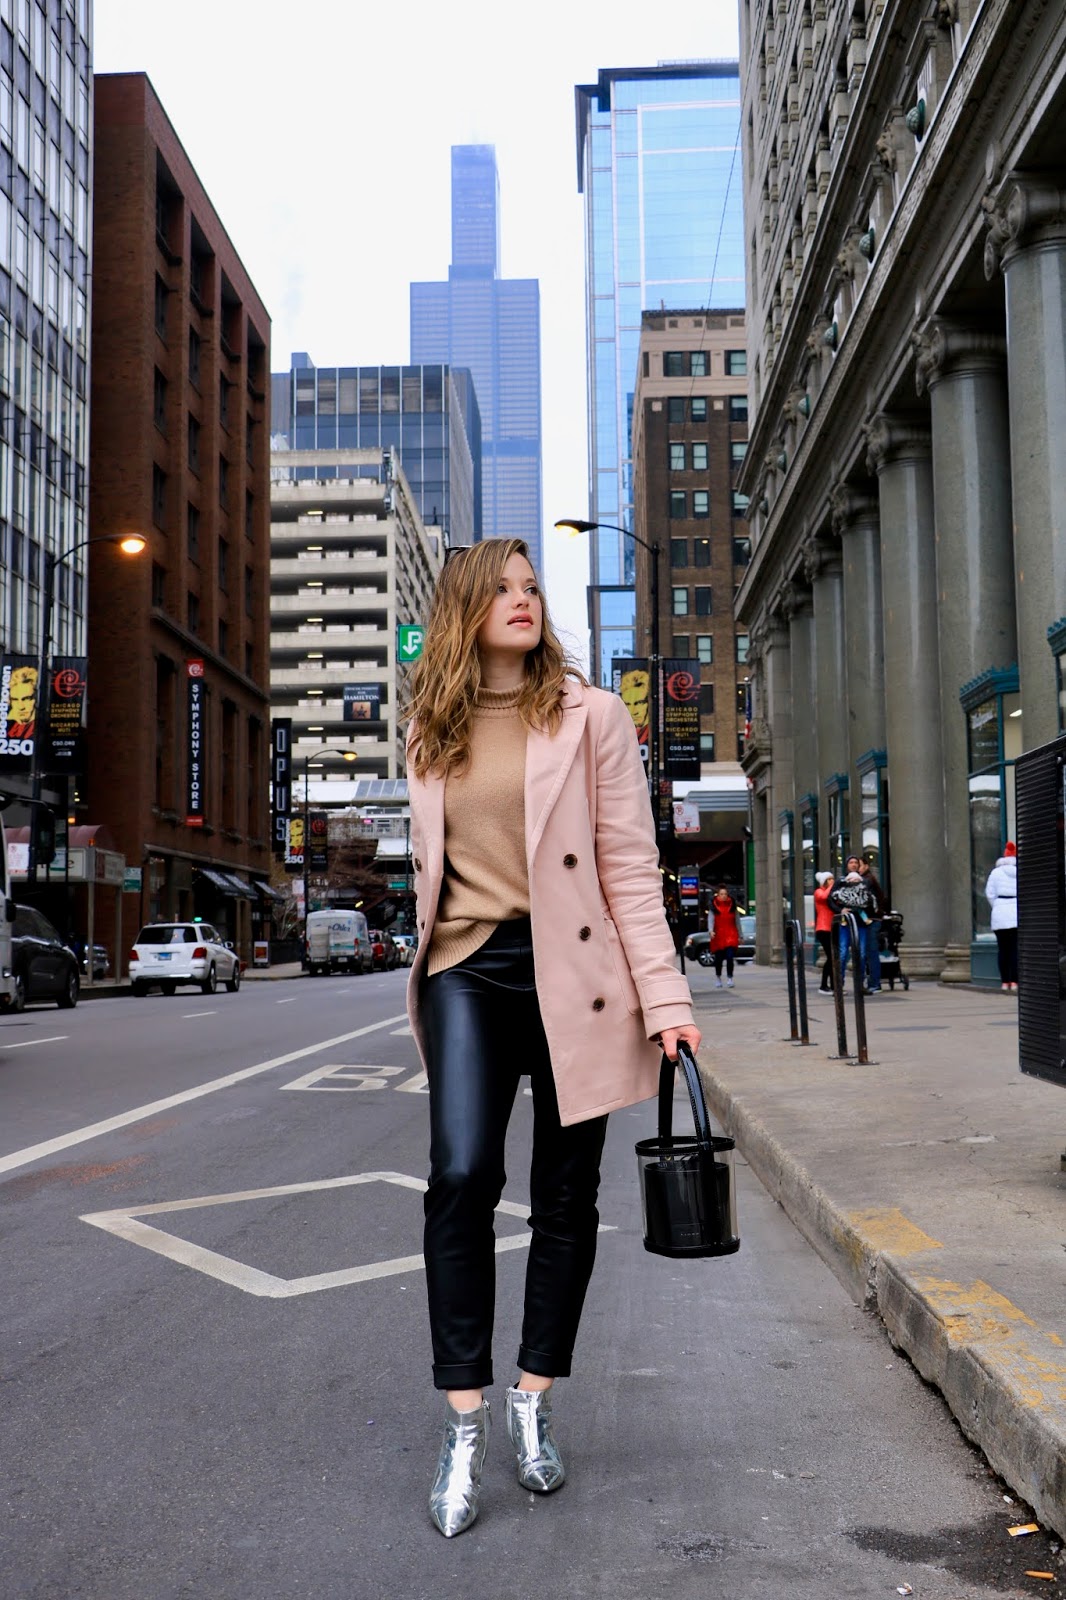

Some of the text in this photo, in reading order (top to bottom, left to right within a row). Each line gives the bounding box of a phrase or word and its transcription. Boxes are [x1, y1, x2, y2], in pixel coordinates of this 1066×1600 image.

[191, 684, 200, 758] SYMPHONY
[0, 739, 34, 756] 250
[191, 763, 200, 809] STORE
[276, 728, 286, 841] OPUS
[284, 855, 304, 864] 250
